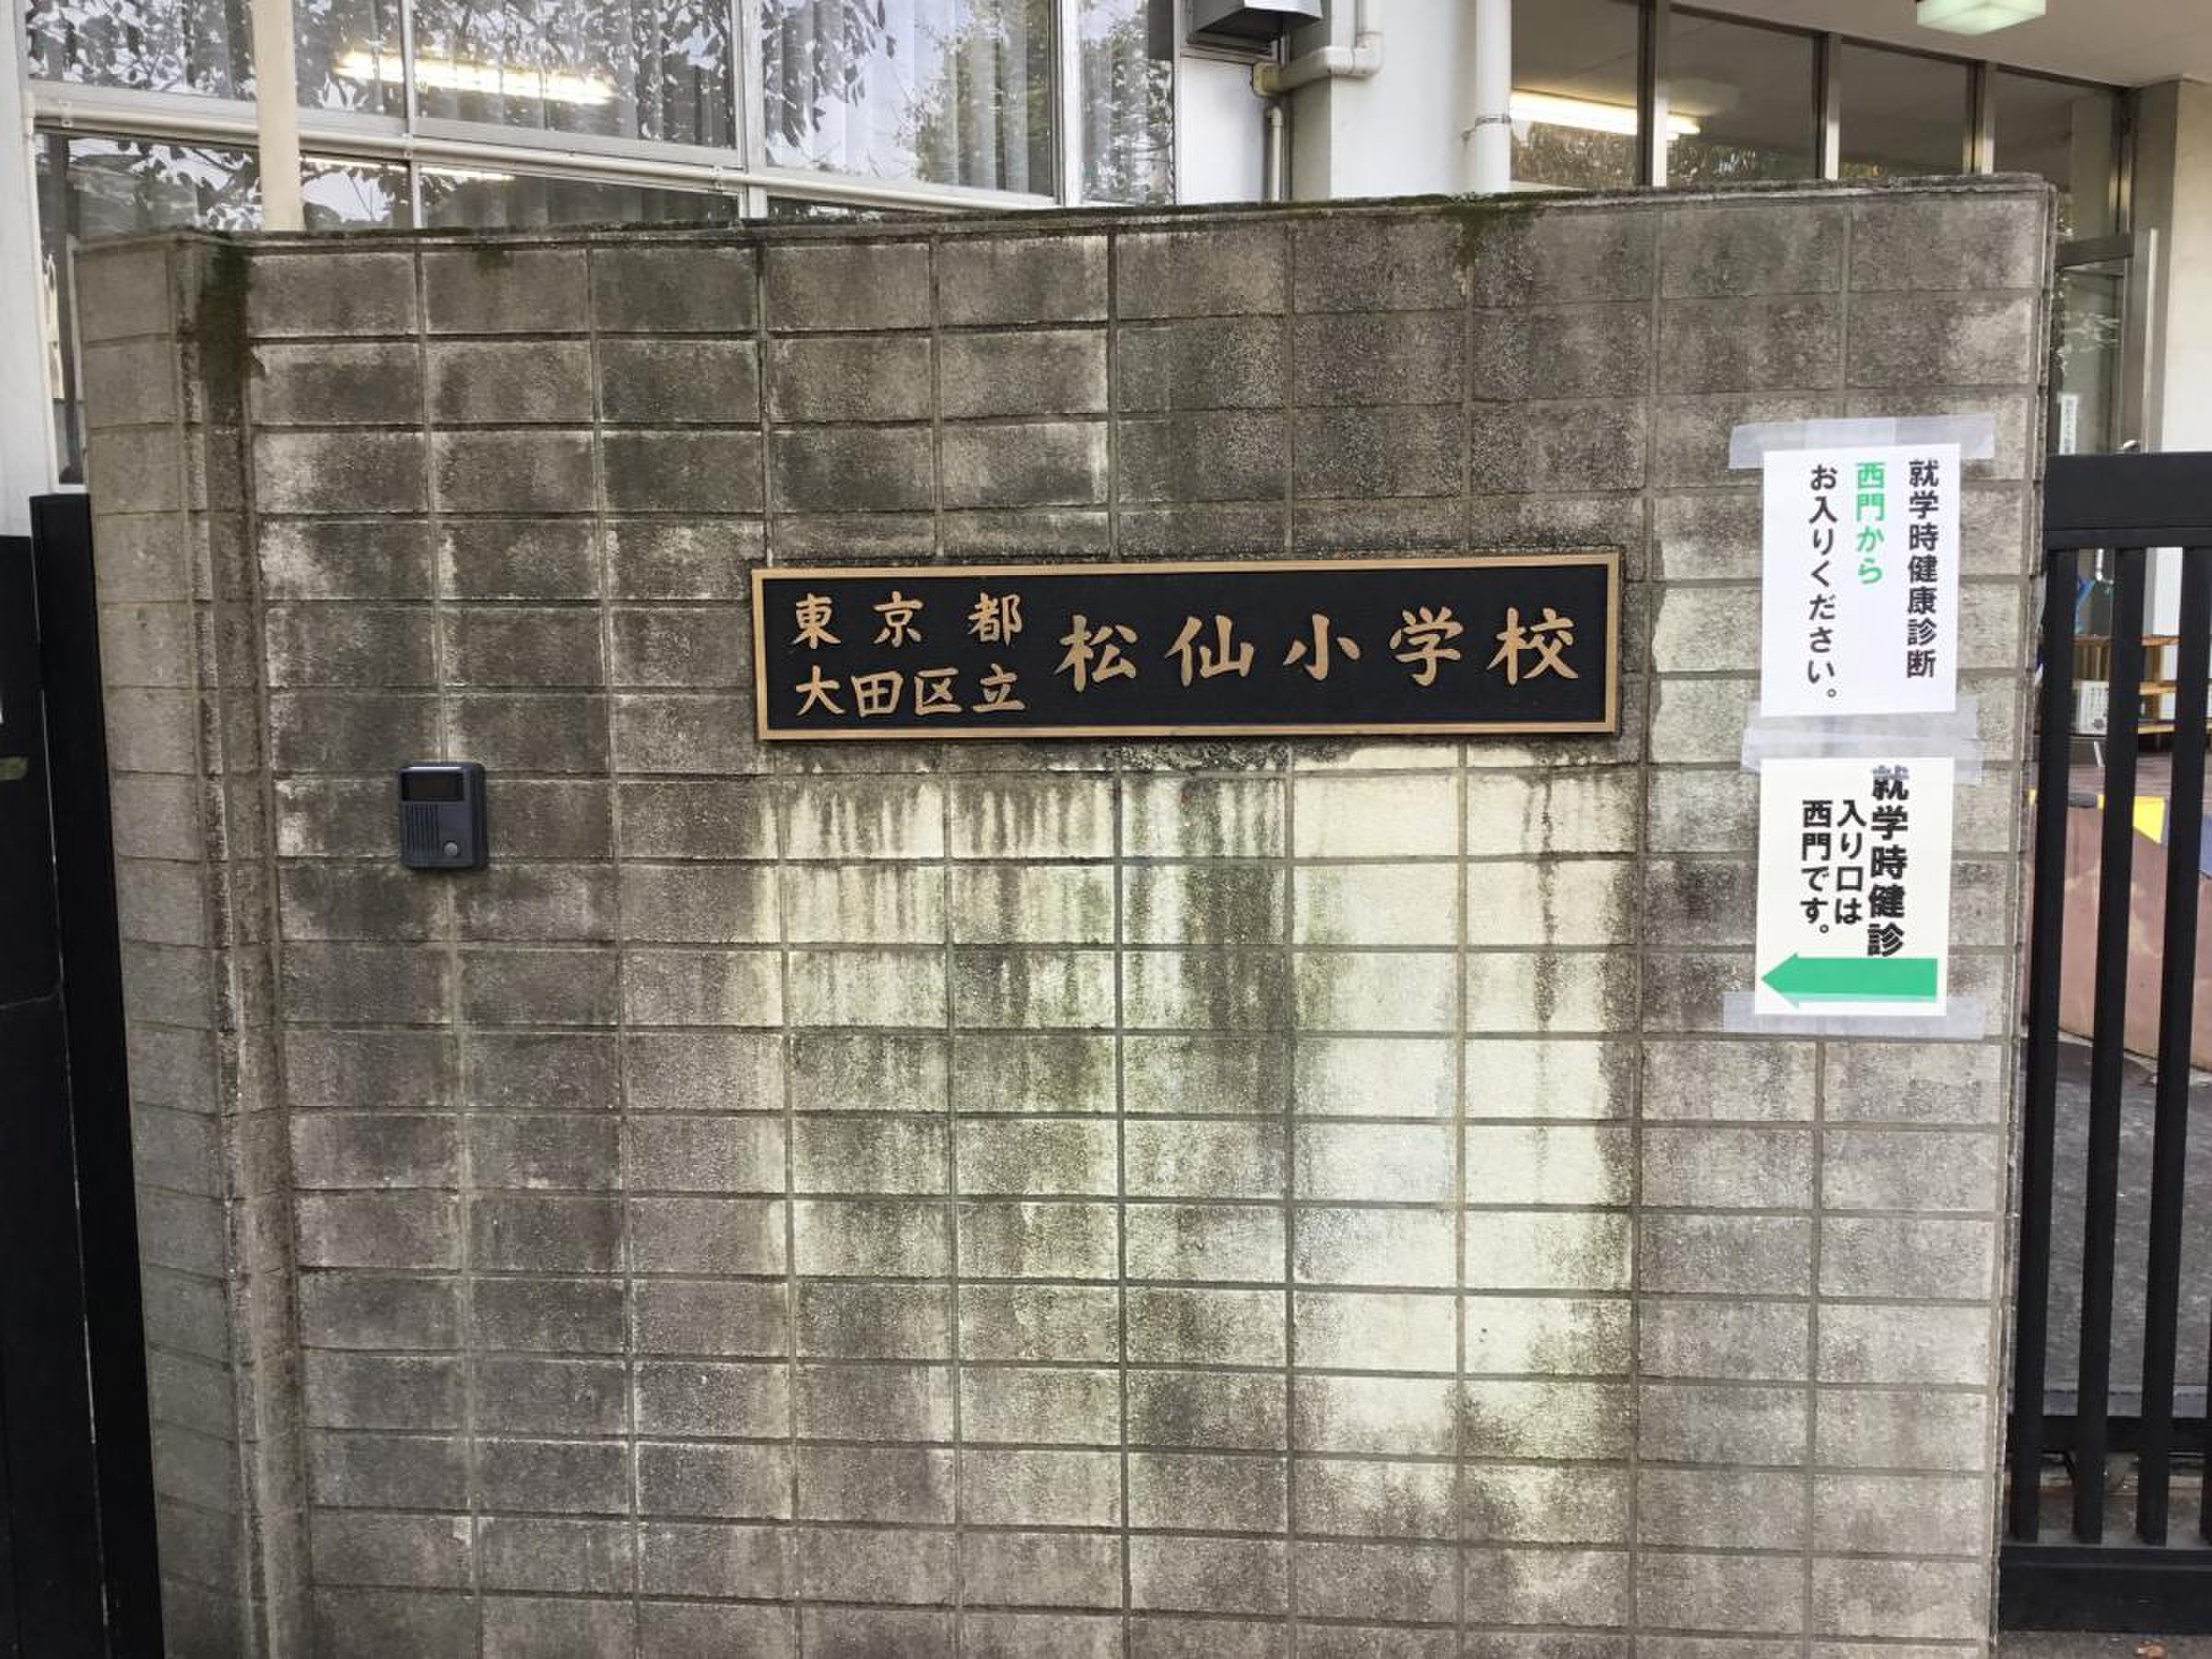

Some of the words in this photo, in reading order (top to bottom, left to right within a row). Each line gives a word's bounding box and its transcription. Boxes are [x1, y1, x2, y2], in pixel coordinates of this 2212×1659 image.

[1807, 464, 1838, 698] お入りください。
[1855, 461, 1887, 585] 西門から
[1906, 459, 1939, 678] 就学時健康診断
[792, 590, 1023, 650] 東京都
[1054, 606, 1580, 692] 松仙小学校
[794, 663, 1026, 718] 大田区立
[1799, 799, 1832, 935] 西門です。
[1834, 799, 1867, 925] 入り口は
[1867, 765, 1910, 957] 就学時健診
